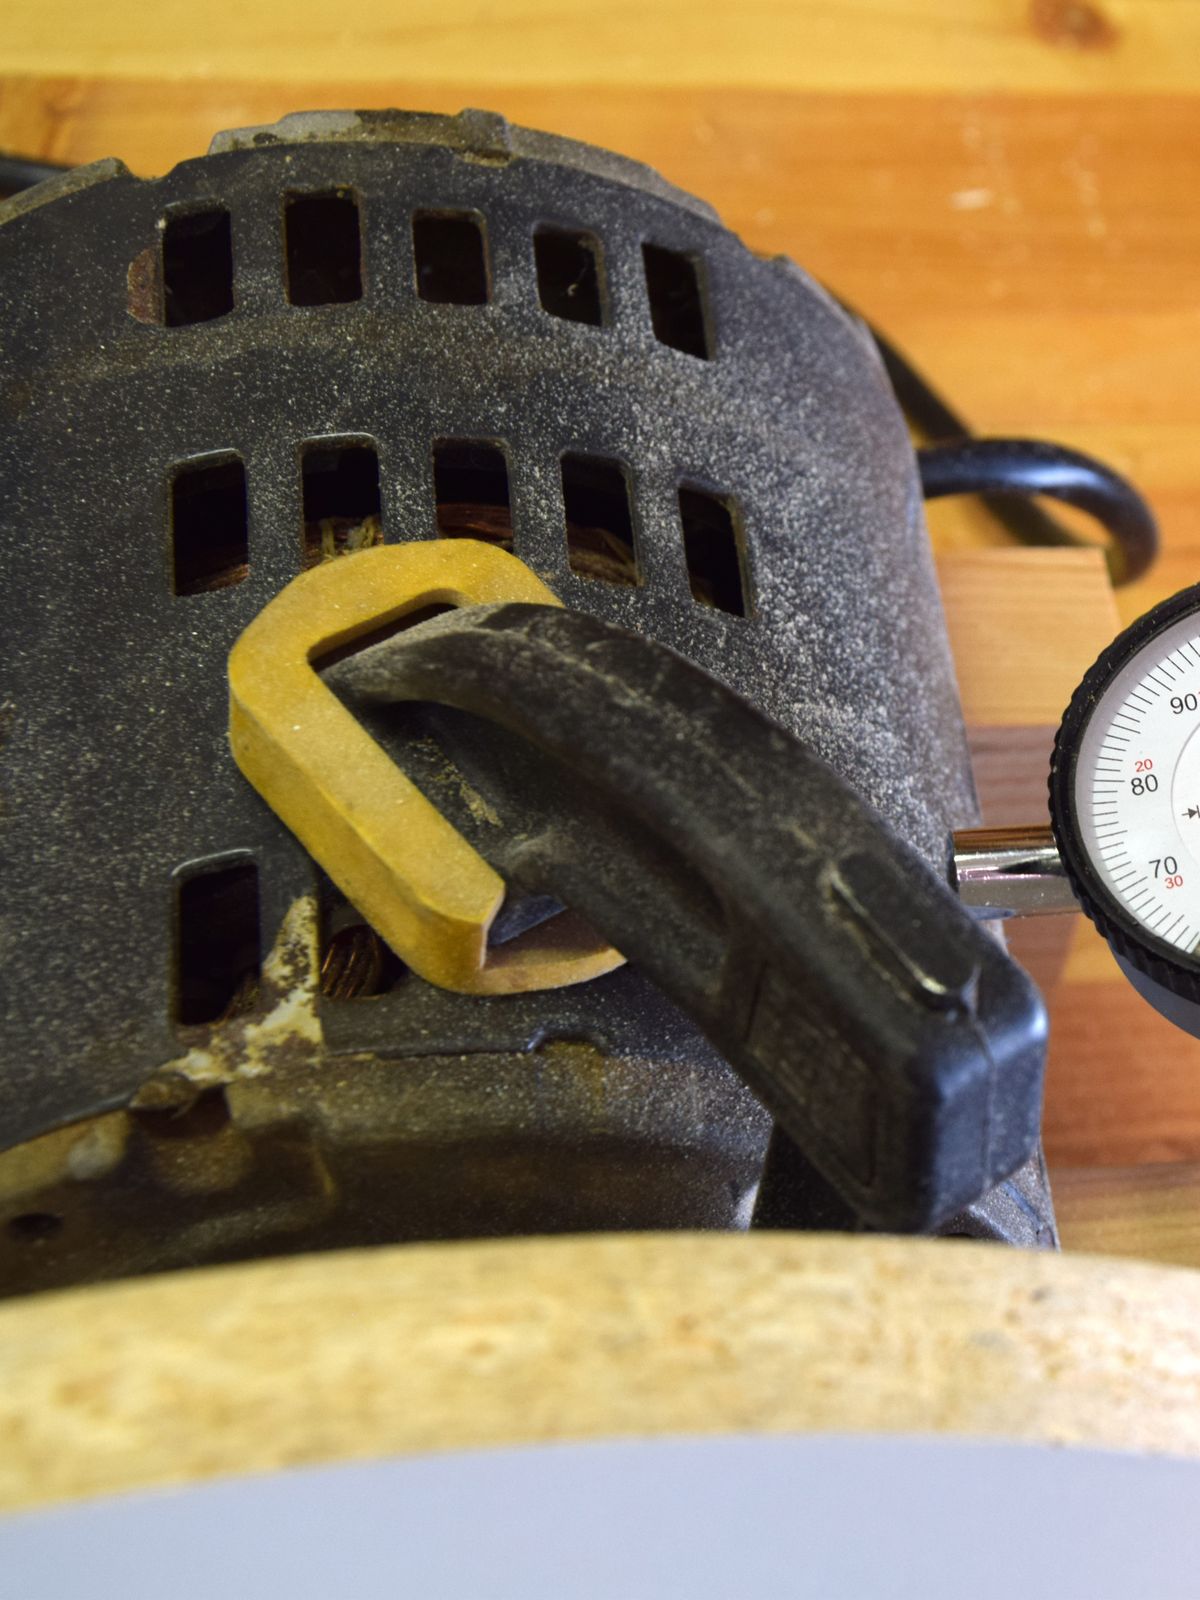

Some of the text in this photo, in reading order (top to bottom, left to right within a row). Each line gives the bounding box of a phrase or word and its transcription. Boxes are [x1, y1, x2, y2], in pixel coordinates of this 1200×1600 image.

[1170, 693, 1198, 715] 90
[1135, 758, 1153, 773] 20
[1131, 774, 1158, 796] 80
[1149, 856, 1178, 878] 70
[1164, 875, 1184, 889] 30
